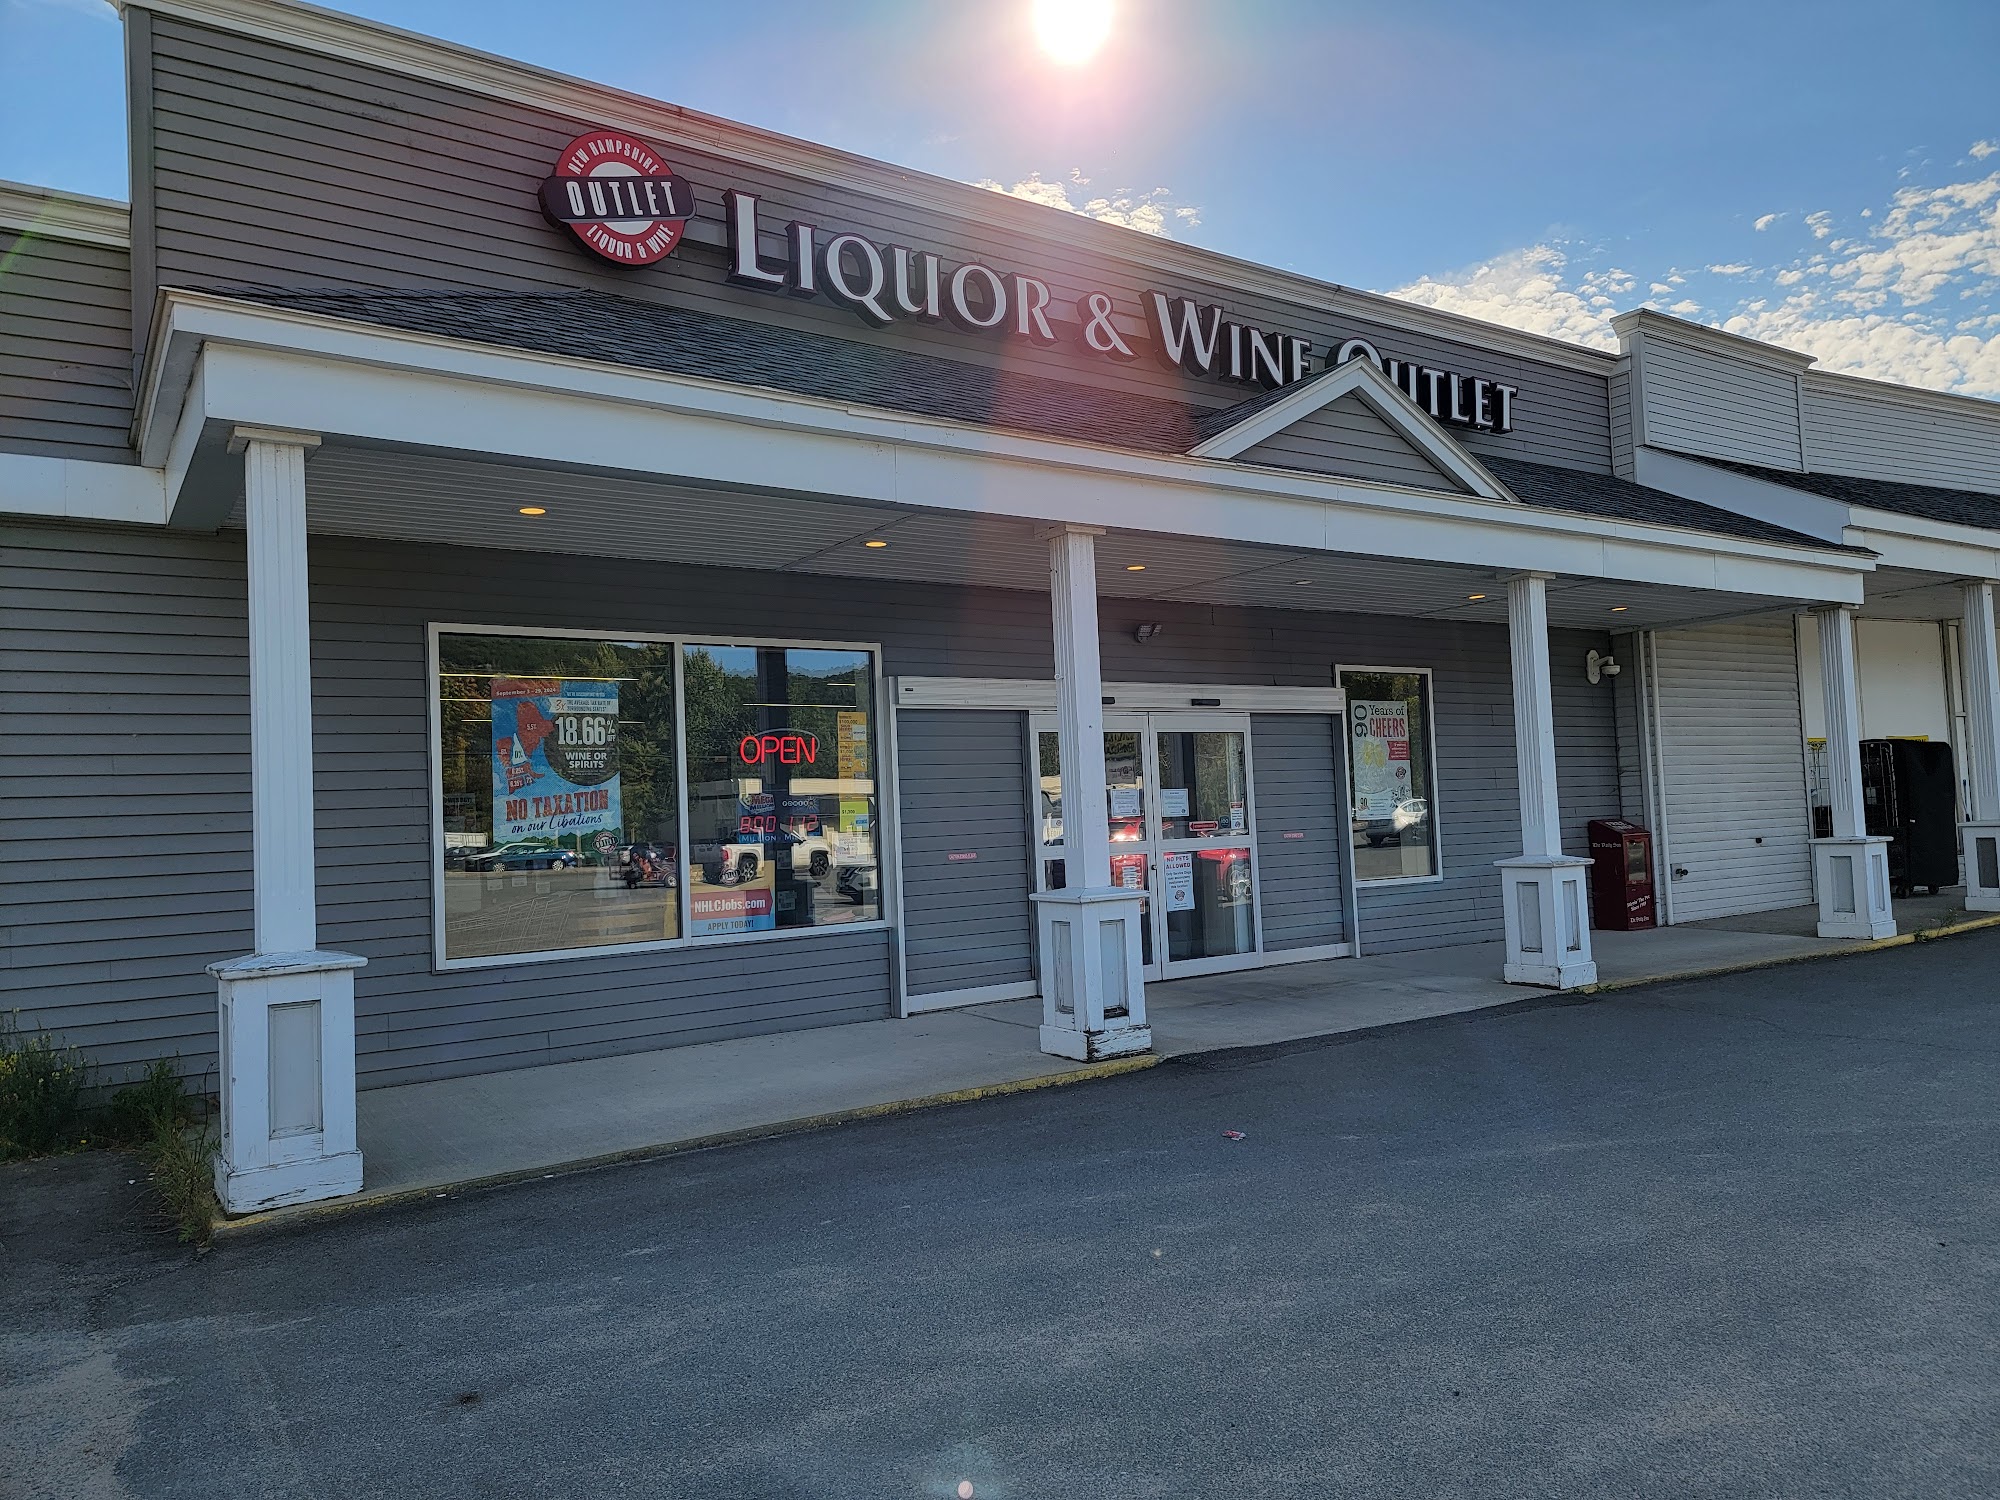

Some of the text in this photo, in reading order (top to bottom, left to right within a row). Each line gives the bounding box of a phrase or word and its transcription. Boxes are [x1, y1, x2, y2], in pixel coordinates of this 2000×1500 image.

[567, 138, 660, 175] NEW HAMPSHIRE
[565, 181, 677, 216] OUTLET
[586, 223, 674, 259] LIQUOR & WINE
[732, 191, 1057, 324] LIQUOR
[1084, 293, 1135, 357] &
[1151, 292, 1312, 387] WINE
[496, 689, 526, 697] September
[1369, 704, 1405, 716] Years of
[1354, 704, 1368, 738] 90
[1369, 717, 1406, 738] CHEERS
[565, 752, 608, 760] WINE OR
[740, 735, 816, 764] OPEN
[569, 761, 605, 769] SPIRITS
[505, 789, 609, 822] NO TAXATION
[511, 812, 604, 834] on our Libations
[740, 815, 777, 833] 800
[741, 834, 777, 842] MILON
[1166, 862, 1191, 870] ALLOWED
[694, 898, 766, 913] NHLCJobs.com
[707, 919, 754, 931] APPLY TODAY!
